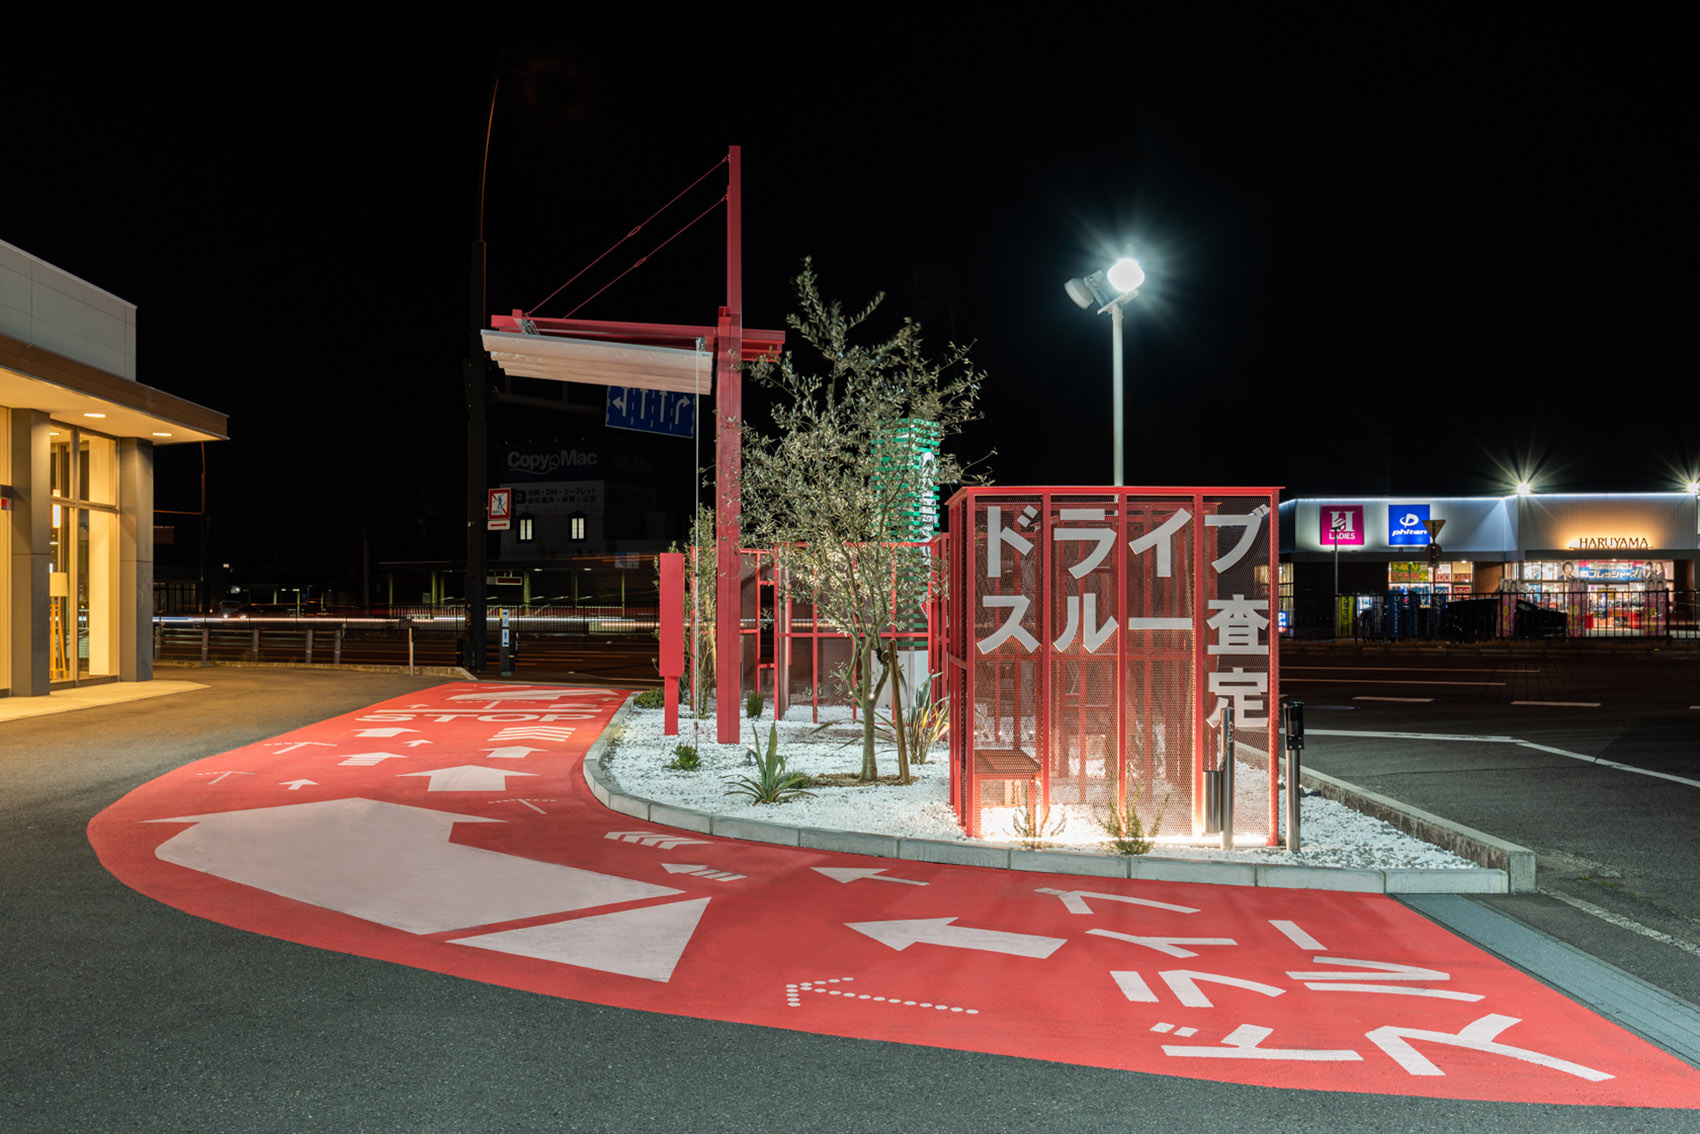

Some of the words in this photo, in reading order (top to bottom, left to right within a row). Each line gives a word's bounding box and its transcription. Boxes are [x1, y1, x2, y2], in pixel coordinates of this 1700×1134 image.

[507, 451, 549, 470] Copy
[560, 449, 597, 466] Mac
[1328, 532, 1356, 540] LADIES
[1391, 528, 1428, 537] phiten
[987, 504, 1271, 579] ドライブ
[1579, 537, 1649, 549] HARUYAMA
[976, 593, 1193, 655] スルー
[354, 713, 597, 723] STOP
[1033, 887, 1364, 1061] ドライブ
